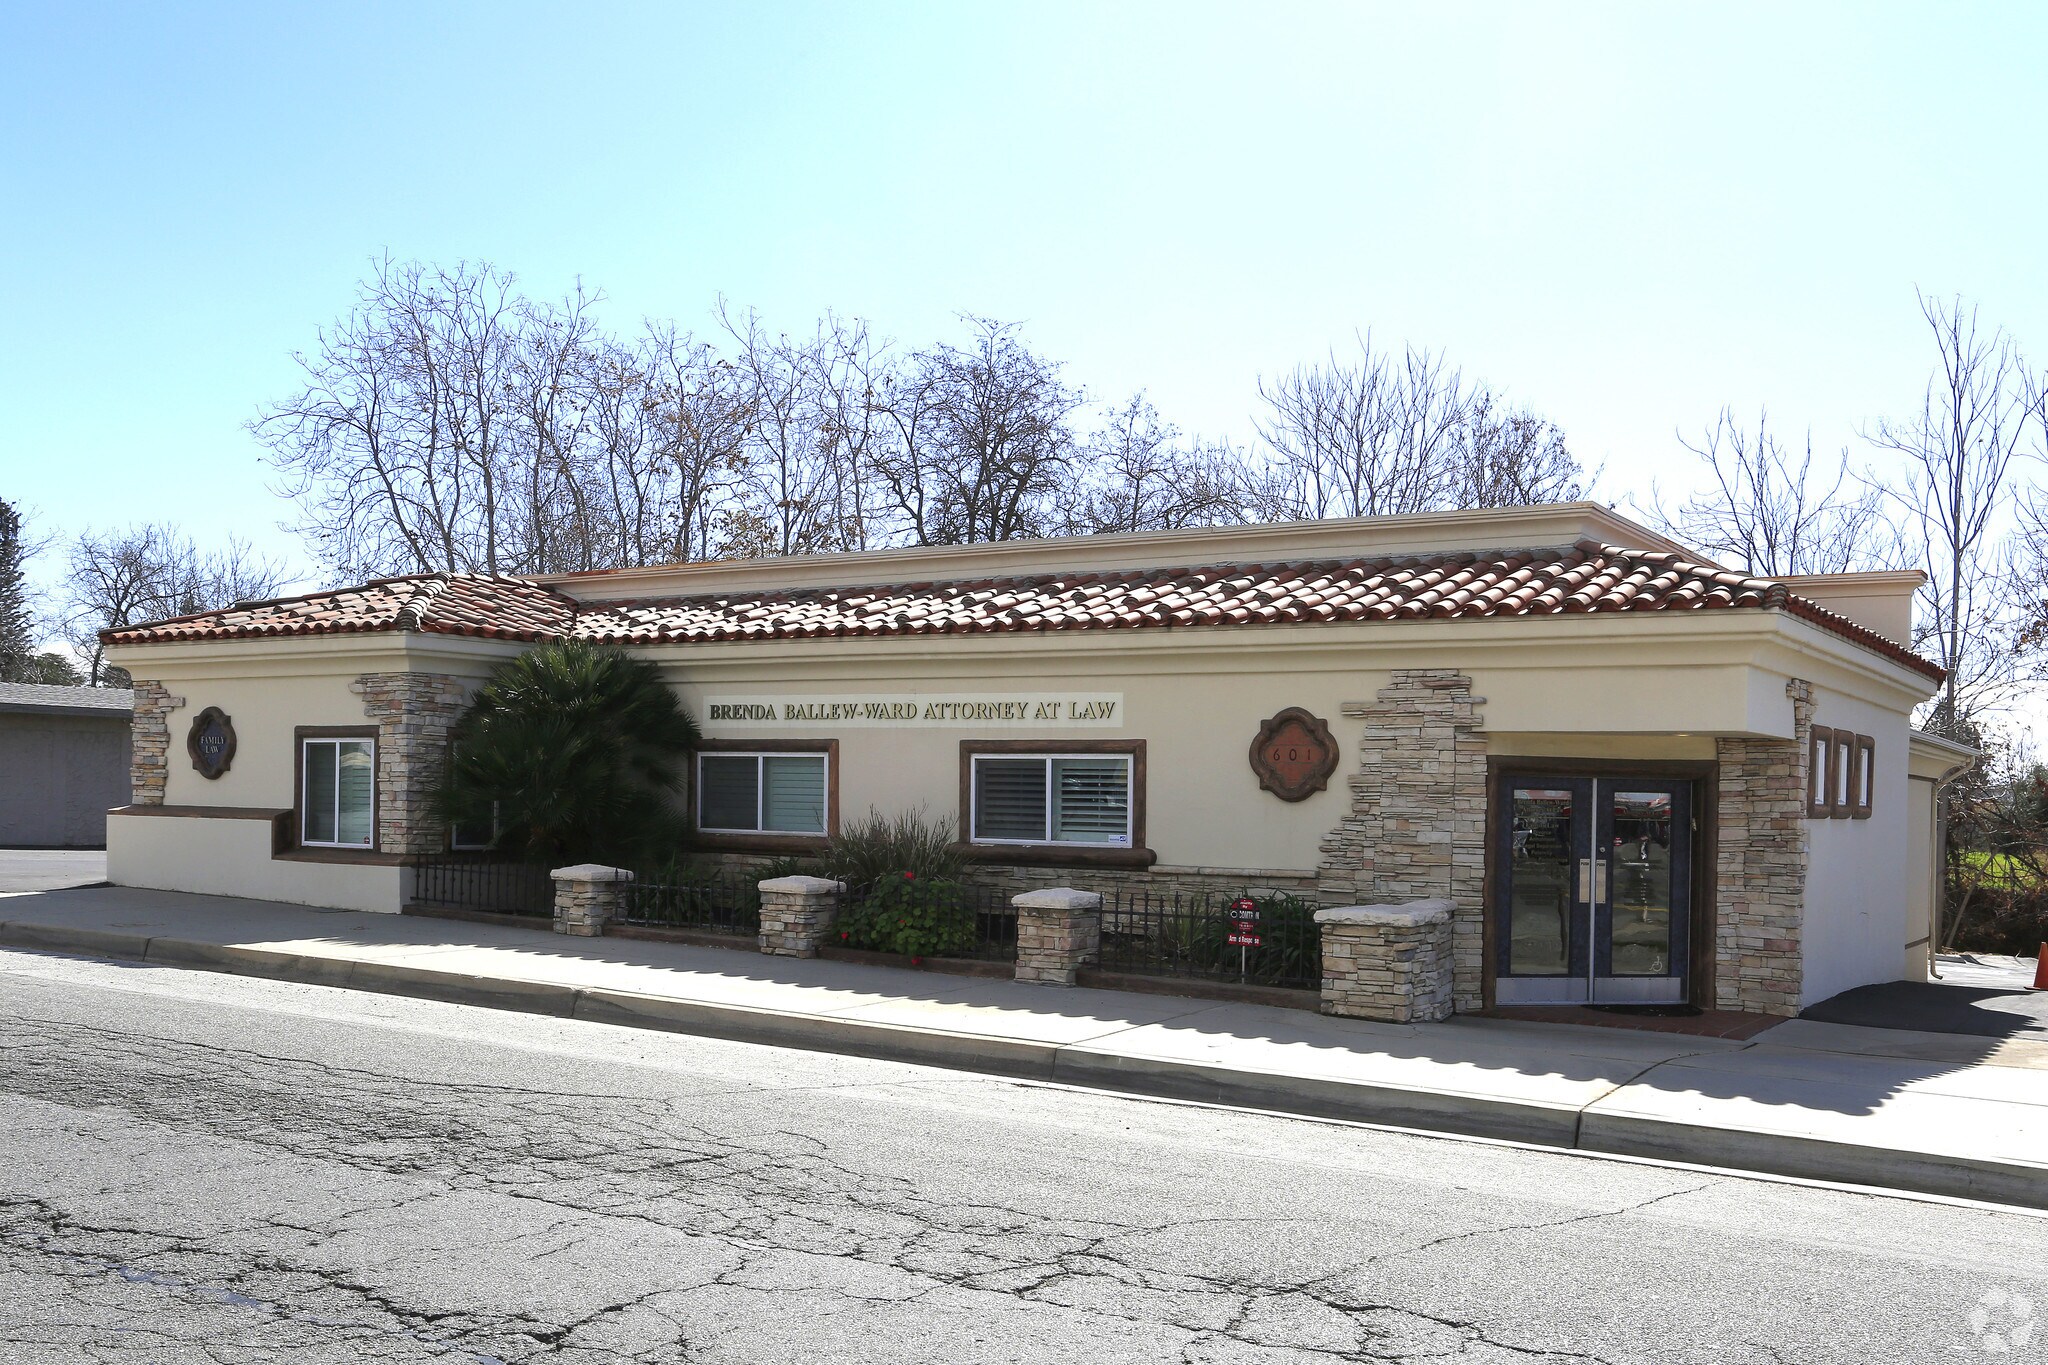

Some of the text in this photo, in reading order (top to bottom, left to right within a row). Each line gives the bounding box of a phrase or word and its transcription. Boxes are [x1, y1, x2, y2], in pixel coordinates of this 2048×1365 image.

[710, 702, 1116, 720] BRENDA BALLEW-WARD ATTORNEY AT LAW
[200, 736, 224, 745] FAMILY
[205, 745, 219, 754] LAW
[1273, 748, 1311, 761] 601
[1228, 935, 1241, 943] Armd
